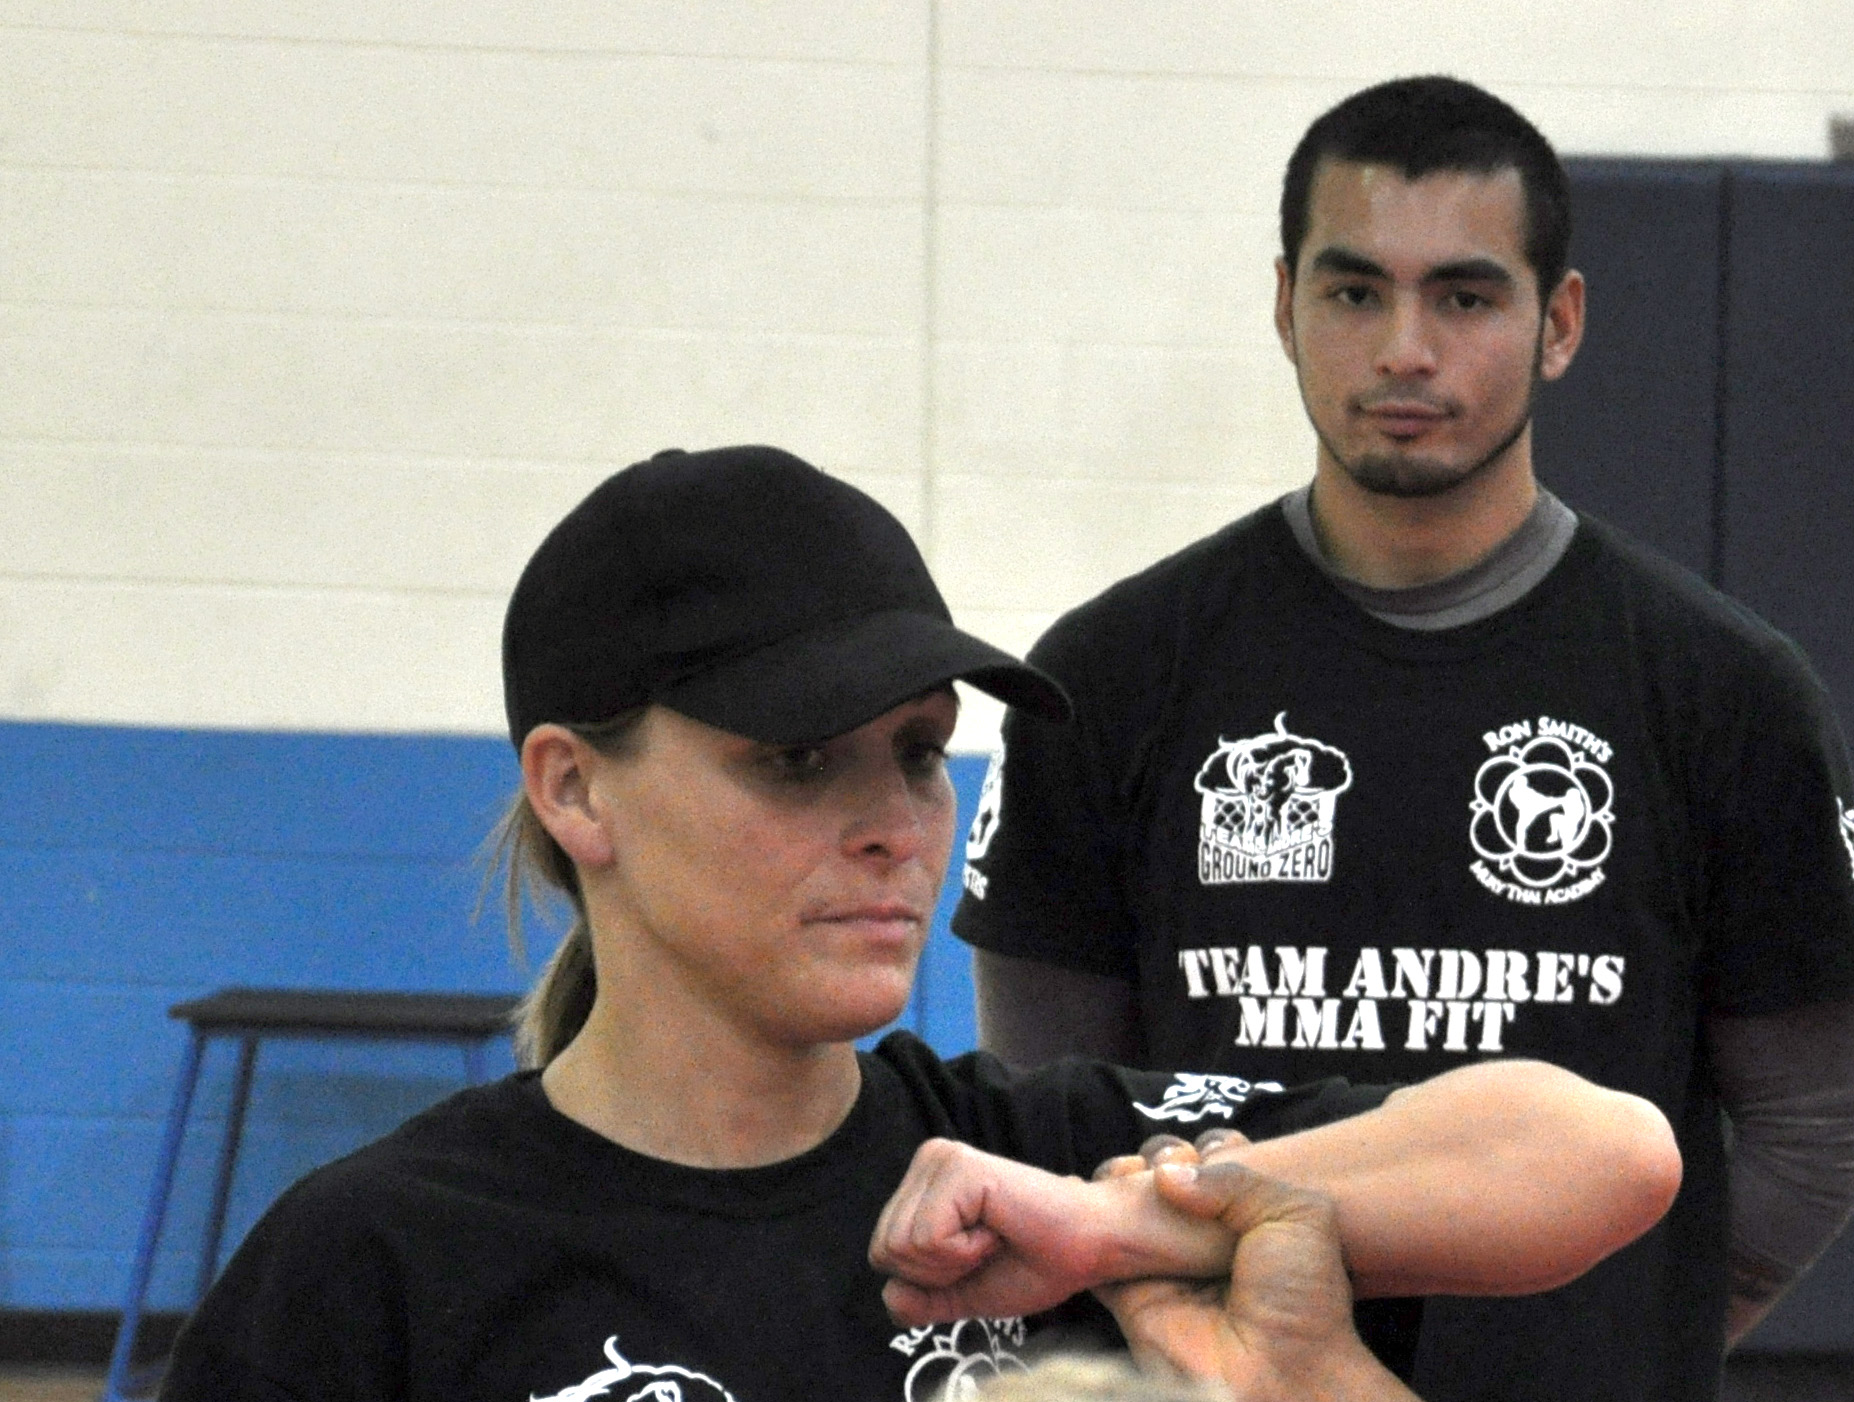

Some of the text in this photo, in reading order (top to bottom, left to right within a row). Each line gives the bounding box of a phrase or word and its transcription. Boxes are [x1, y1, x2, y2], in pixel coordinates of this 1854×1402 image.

[1483, 720, 1531, 751] RON
[1201, 839, 1331, 882] GROUND ZERO
[1178, 946, 1625, 1005] TEAM ANDRE'S
[1235, 996, 1516, 1051] MMA FIT
